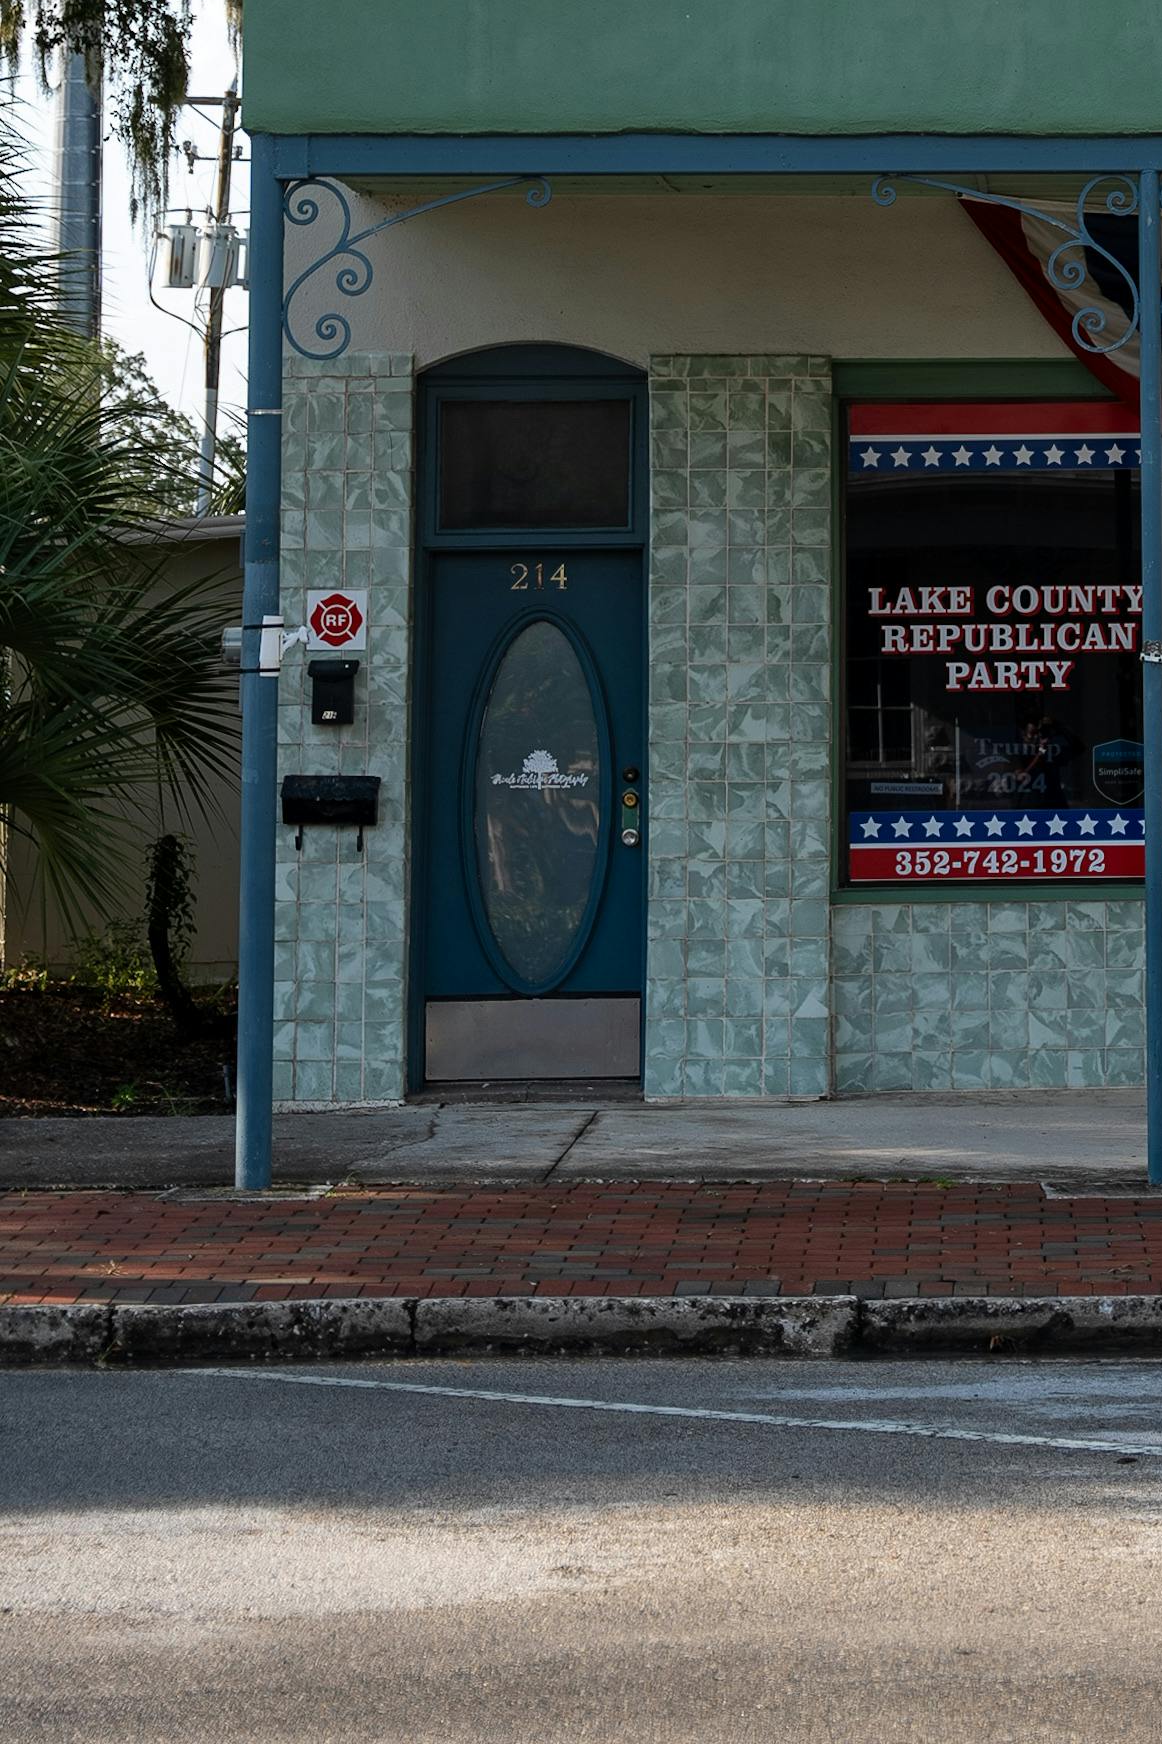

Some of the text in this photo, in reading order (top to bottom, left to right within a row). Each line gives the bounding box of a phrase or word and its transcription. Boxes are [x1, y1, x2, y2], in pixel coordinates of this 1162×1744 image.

[510, 562, 568, 591] 214
[868, 584, 1143, 617] LAKE COUNTY
[324, 614, 347, 626] RF
[881, 622, 1139, 654] REPUBLICAN
[945, 660, 1073, 692] PARTY
[973, 737, 1062, 763] Trump
[986, 771, 1048, 794] 2024
[1098, 767, 1143, 777] SimpliSafe
[874, 785, 883, 793] NO
[895, 848, 1106, 876] 352-742-1972
